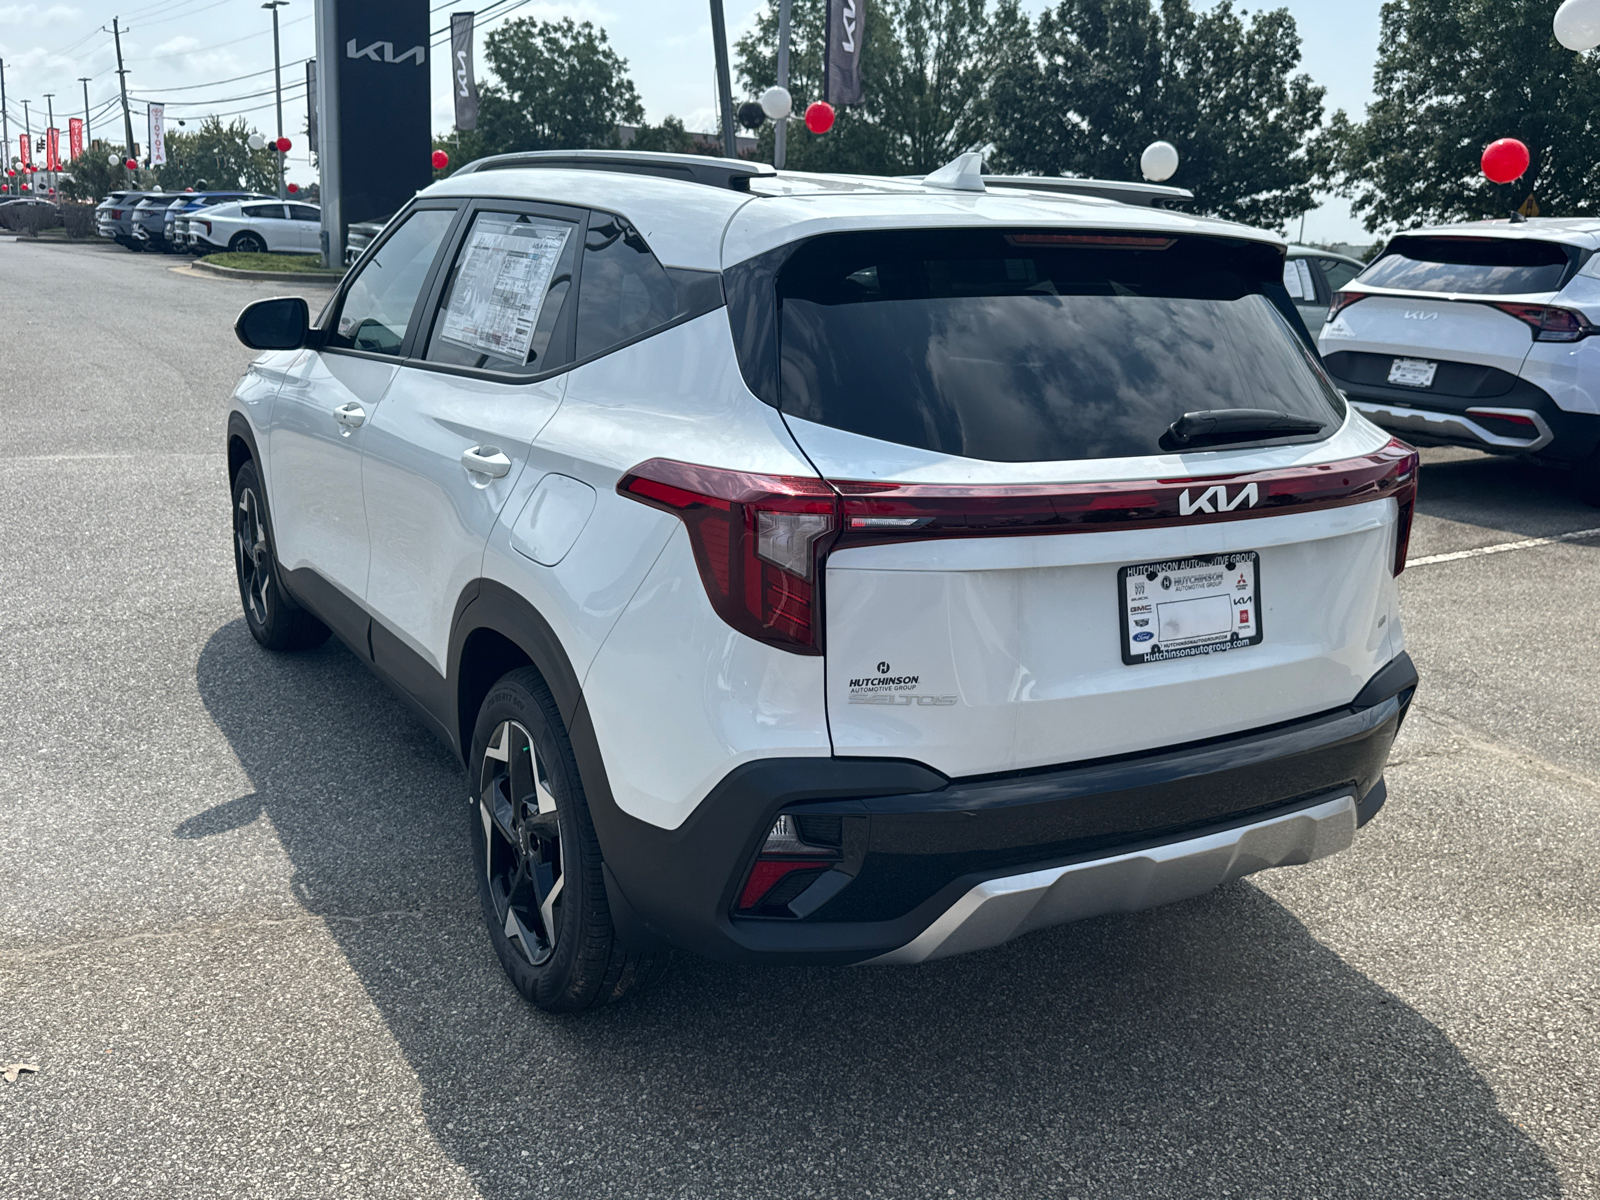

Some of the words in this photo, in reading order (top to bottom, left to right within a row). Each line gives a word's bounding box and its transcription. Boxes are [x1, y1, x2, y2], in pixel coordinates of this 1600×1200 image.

[346, 37, 425, 66] KIA
[456, 50, 469, 97] KIA
[154, 117, 163, 161] TOYOTA
[1404, 310, 1438, 320] KIA
[1179, 482, 1259, 516] KIA
[1127, 561, 1179, 577] HUTCHINSON
[1230, 552, 1256, 564] GROUP
[1173, 572, 1224, 587] HUTCHINSON
[1175, 582, 1205, 592] AUTOMOTIVE
[1206, 580, 1222, 588] GROUP
[1233, 596, 1252, 605] KIA
[1130, 604, 1152, 613] GMC
[1144, 639, 1250, 662] Hutchinsonautogroup.com
[849, 675, 919, 687] HUTCHINSON
[850, 685, 892, 693] AUTOMOTIVE
[848, 694, 958, 706] SELTOS
